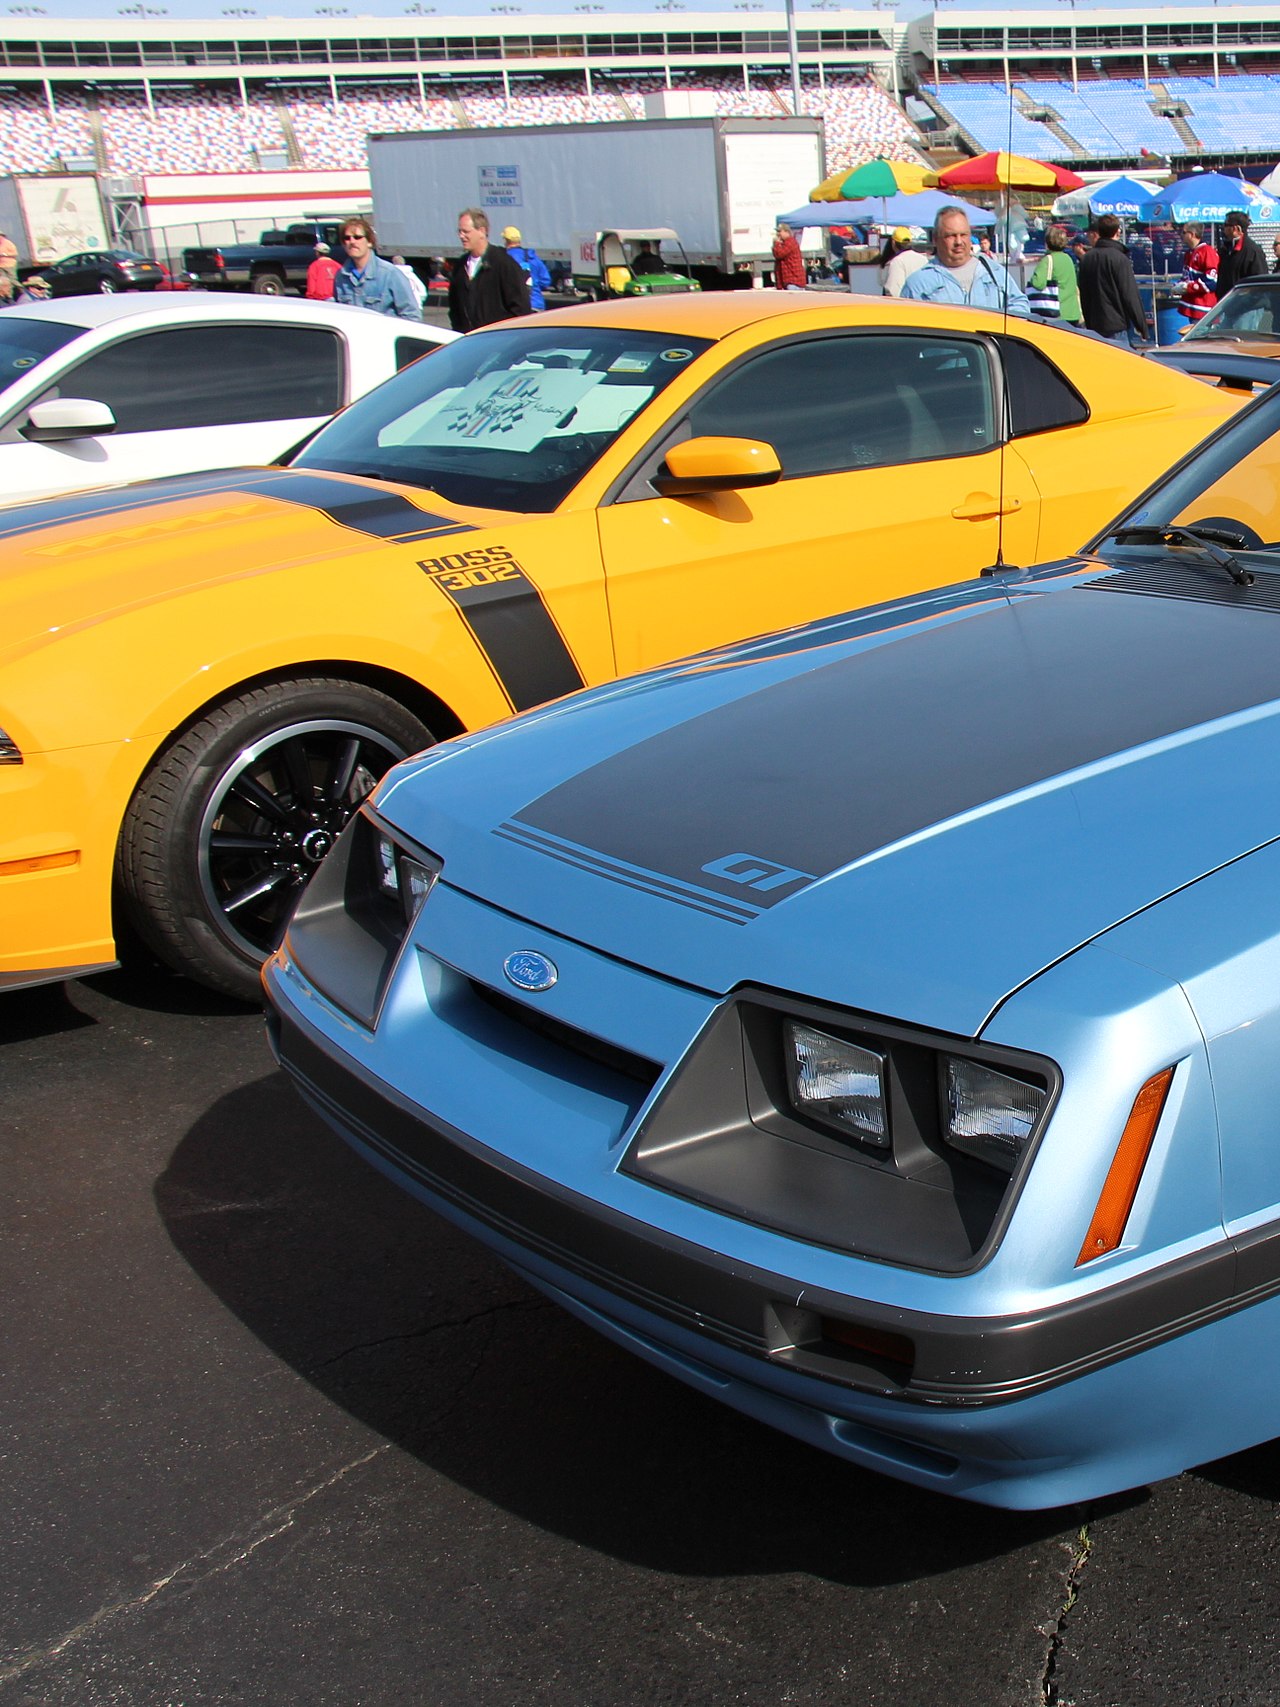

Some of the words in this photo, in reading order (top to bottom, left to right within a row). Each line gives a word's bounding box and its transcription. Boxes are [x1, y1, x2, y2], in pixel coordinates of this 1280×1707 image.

[1098, 203, 1114, 212] Ice
[1179, 207, 1198, 217] ICE
[416, 546, 513, 575] BOSS
[439, 562, 521, 591] 302
[701, 852, 819, 892] GT
